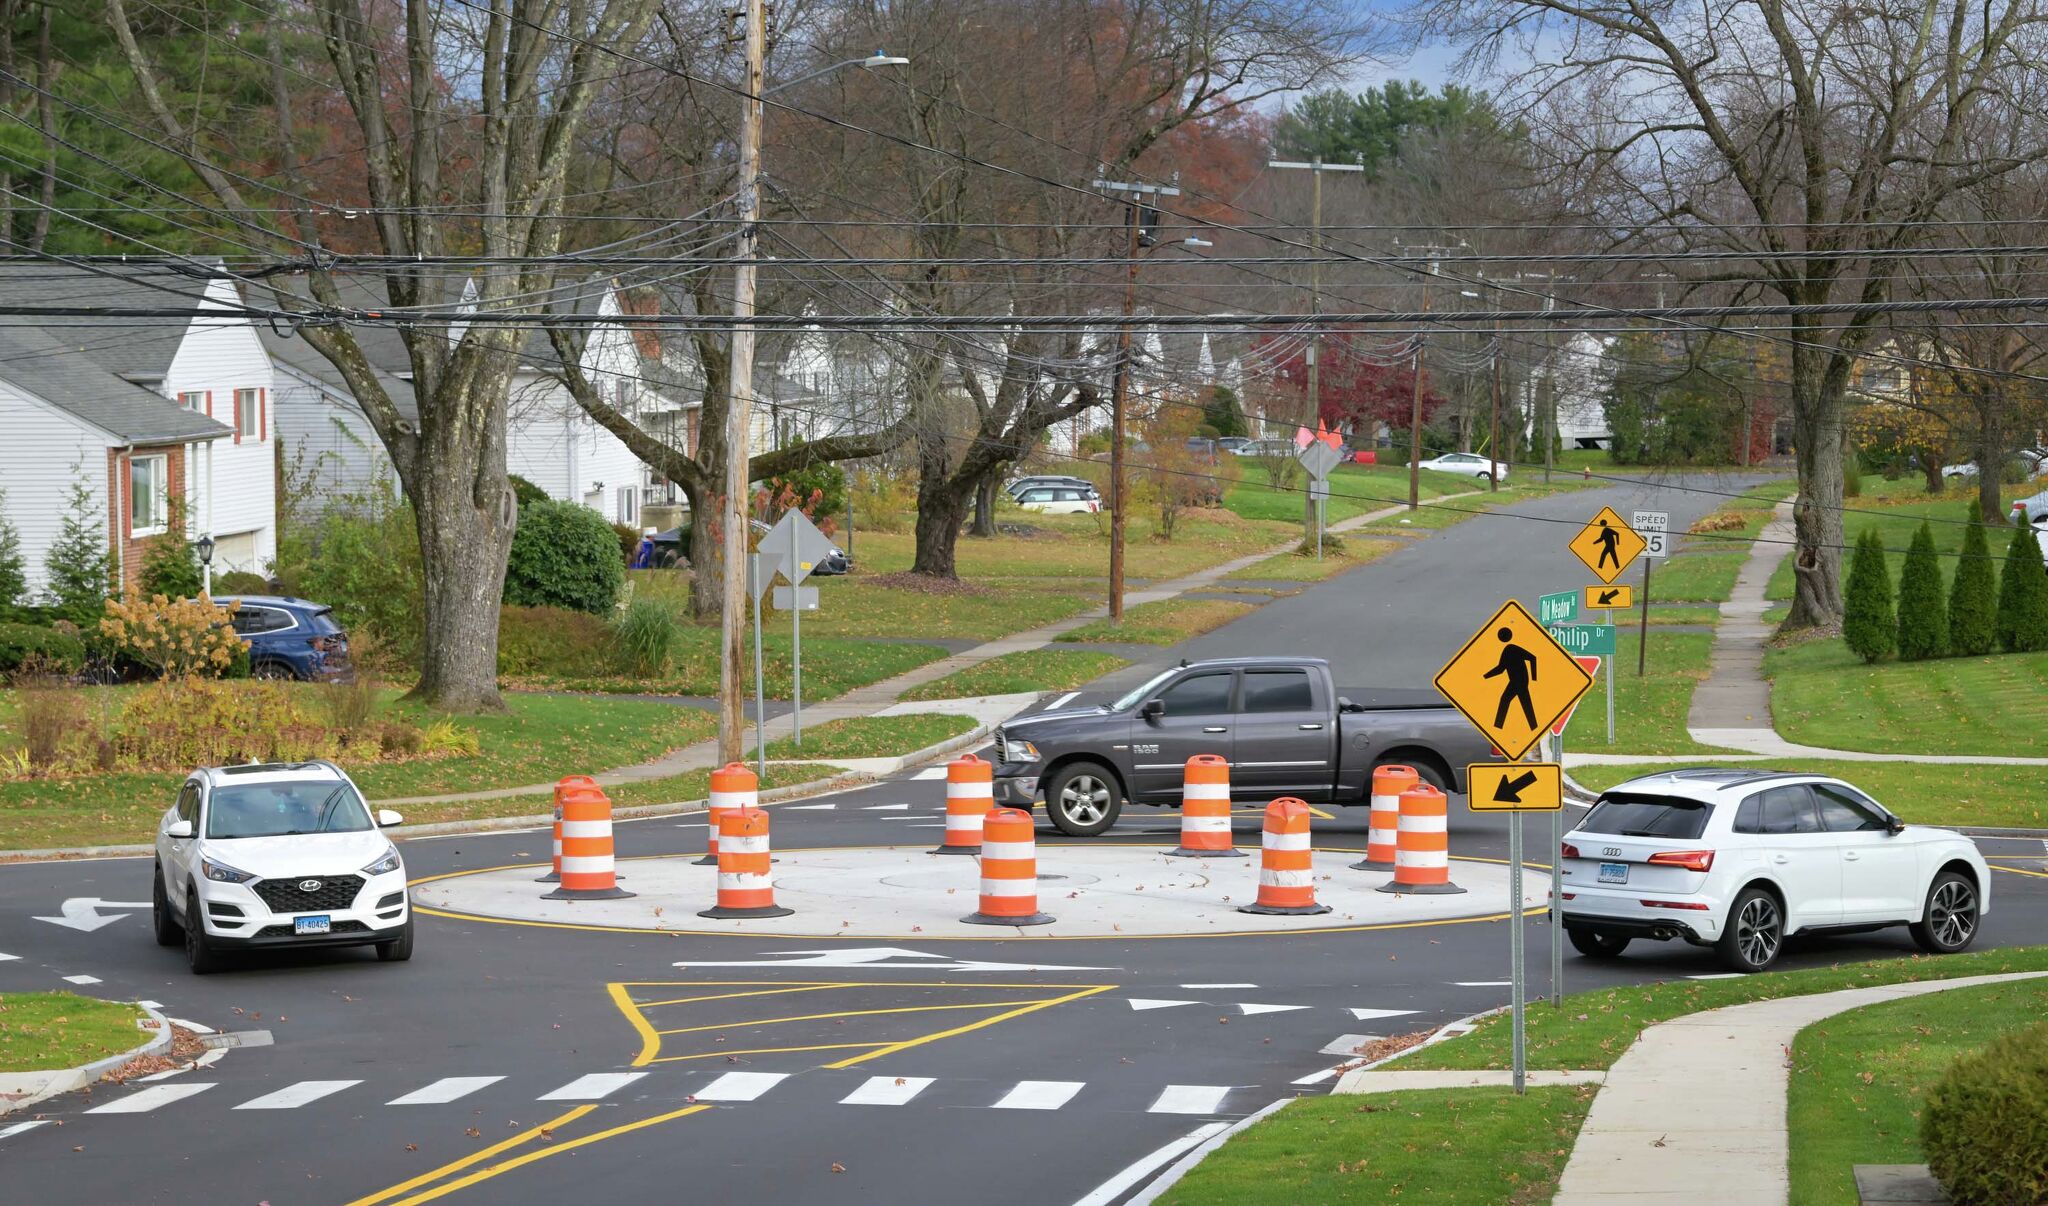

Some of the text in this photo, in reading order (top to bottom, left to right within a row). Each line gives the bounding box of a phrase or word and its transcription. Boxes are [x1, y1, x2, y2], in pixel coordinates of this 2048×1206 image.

[1635, 515, 1666, 525] SPEED
[1637, 525, 1662, 533] LIMIT
[1541, 599, 1550, 622] Old
[1551, 598, 1570, 620] Meadow
[1549, 626, 1605, 650] Philip Dr
